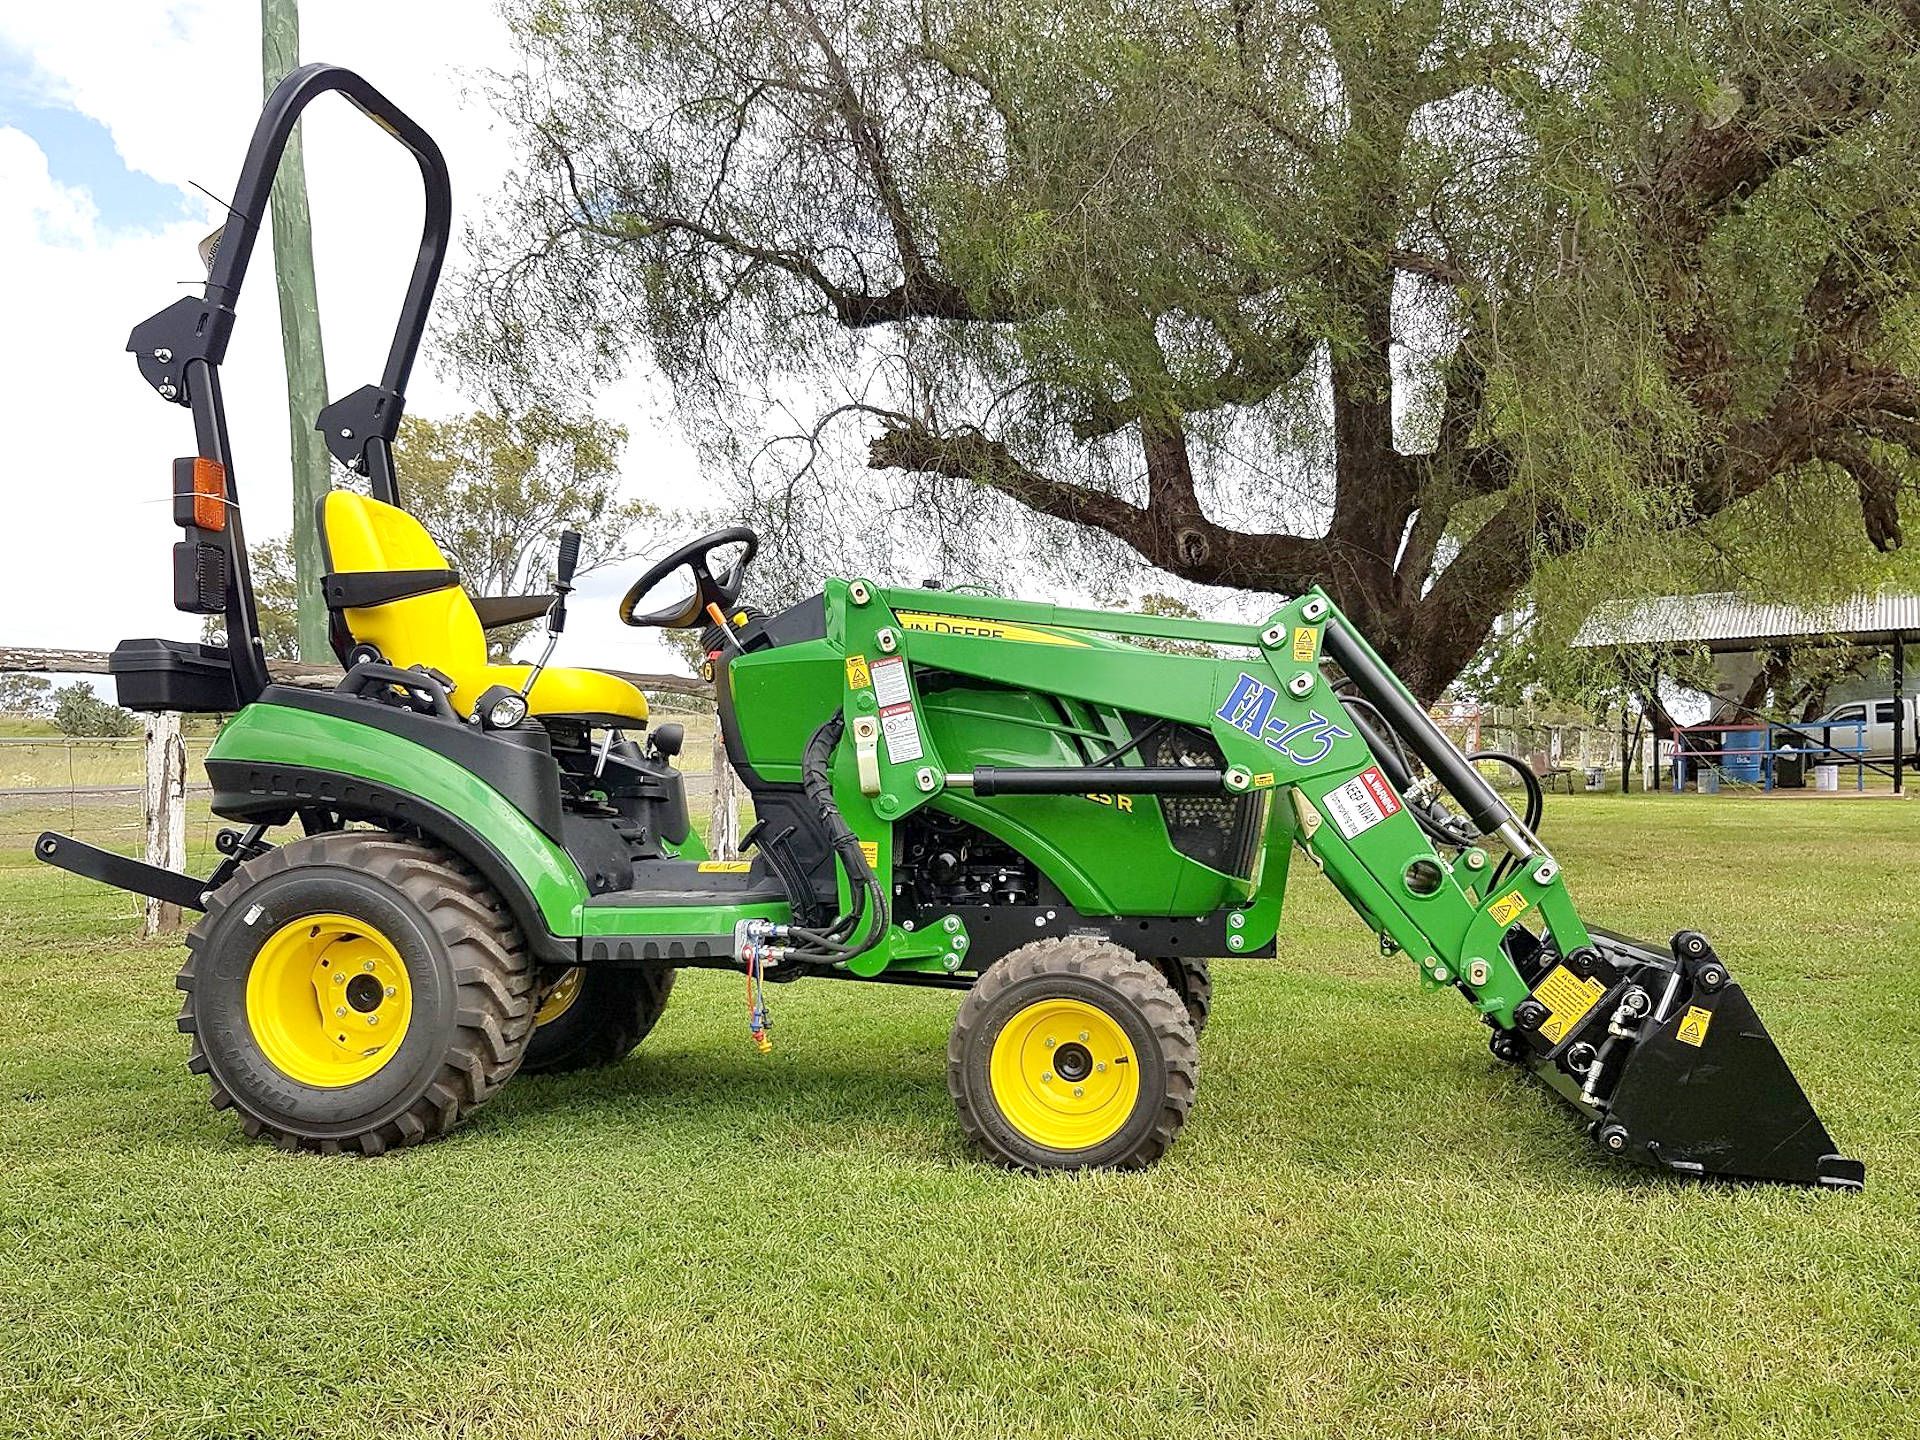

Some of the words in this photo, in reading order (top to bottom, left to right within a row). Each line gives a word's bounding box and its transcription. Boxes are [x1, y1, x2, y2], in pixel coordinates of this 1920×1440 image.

[1344, 781, 1364, 802] KEEP
[1356, 801, 1378, 824] AWAY
[1370, 779, 1397, 814] WARNING
[1567, 978, 1591, 999] CAUTION
